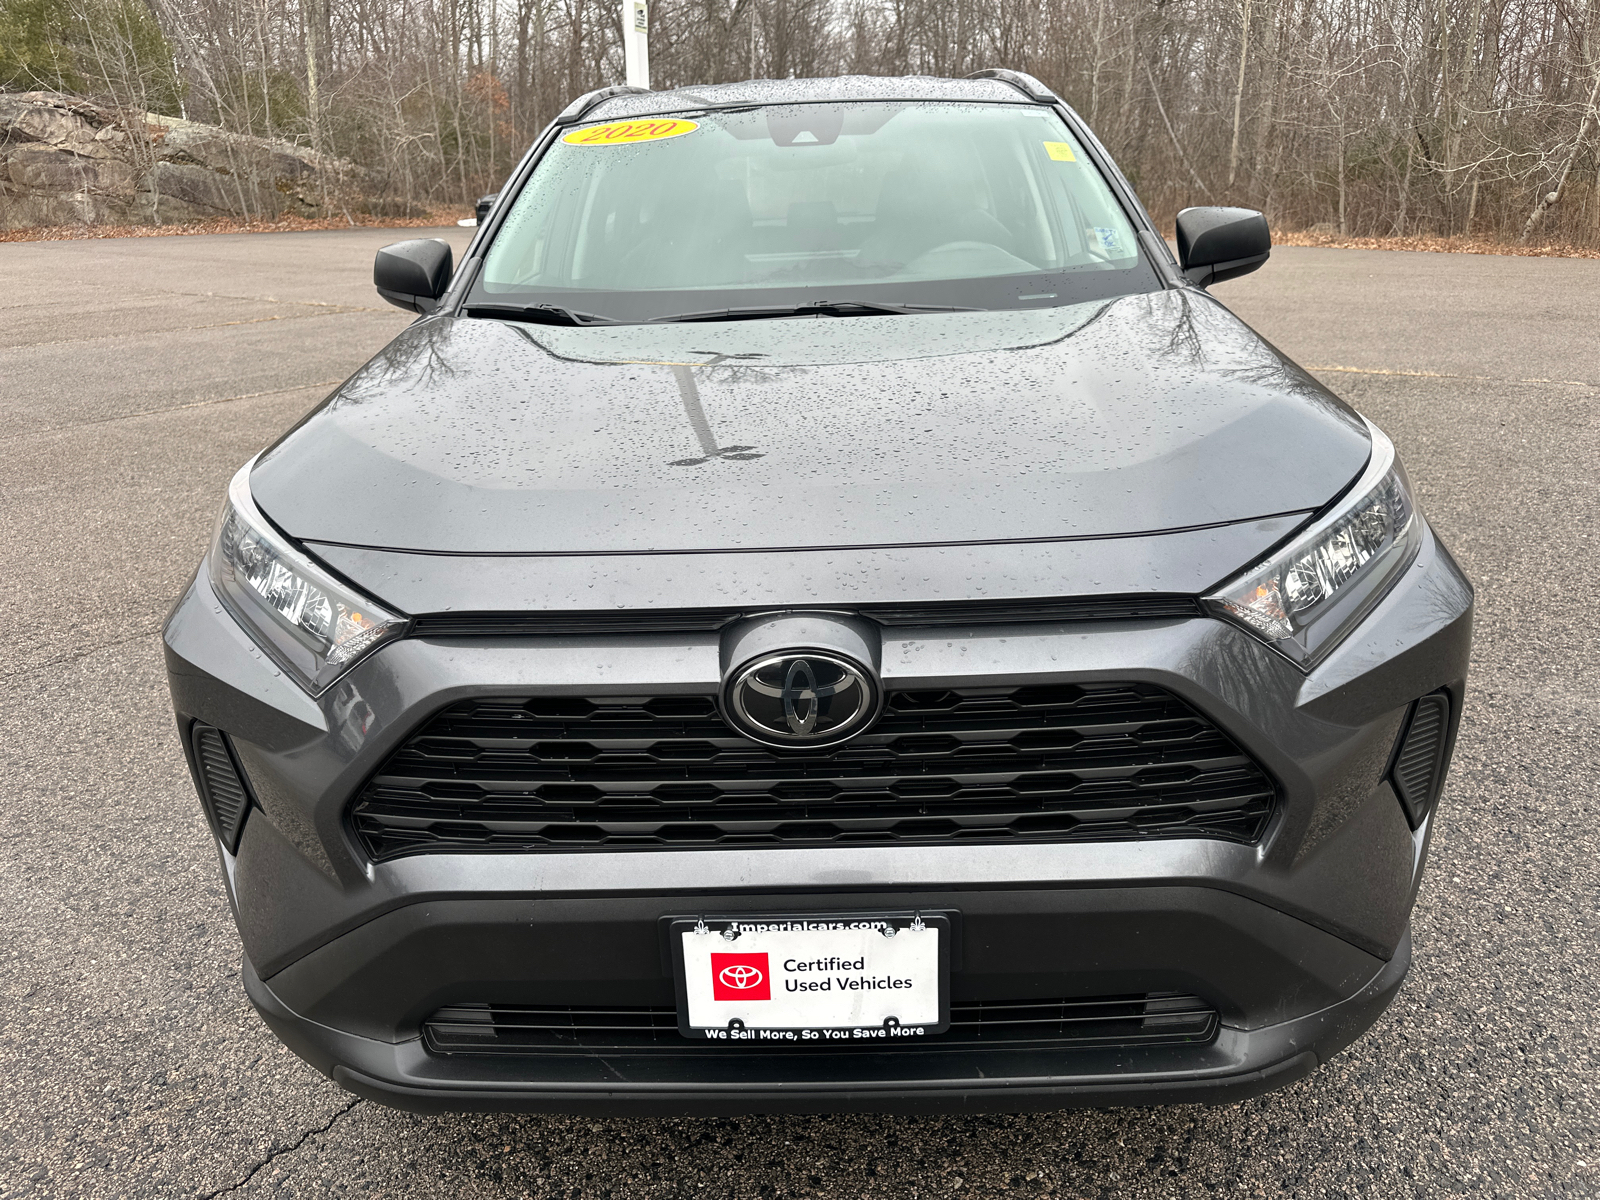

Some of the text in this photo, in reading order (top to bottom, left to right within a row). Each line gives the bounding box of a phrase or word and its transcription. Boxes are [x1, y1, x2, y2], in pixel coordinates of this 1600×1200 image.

[581, 122, 677, 142] 2020
[731, 921, 887, 933] Imperialcars.com
[783, 957, 865, 972] Certified
[785, 975, 913, 992] Used Vehicles
[705, 1026, 925, 1041] We Sell More, So You Save More
